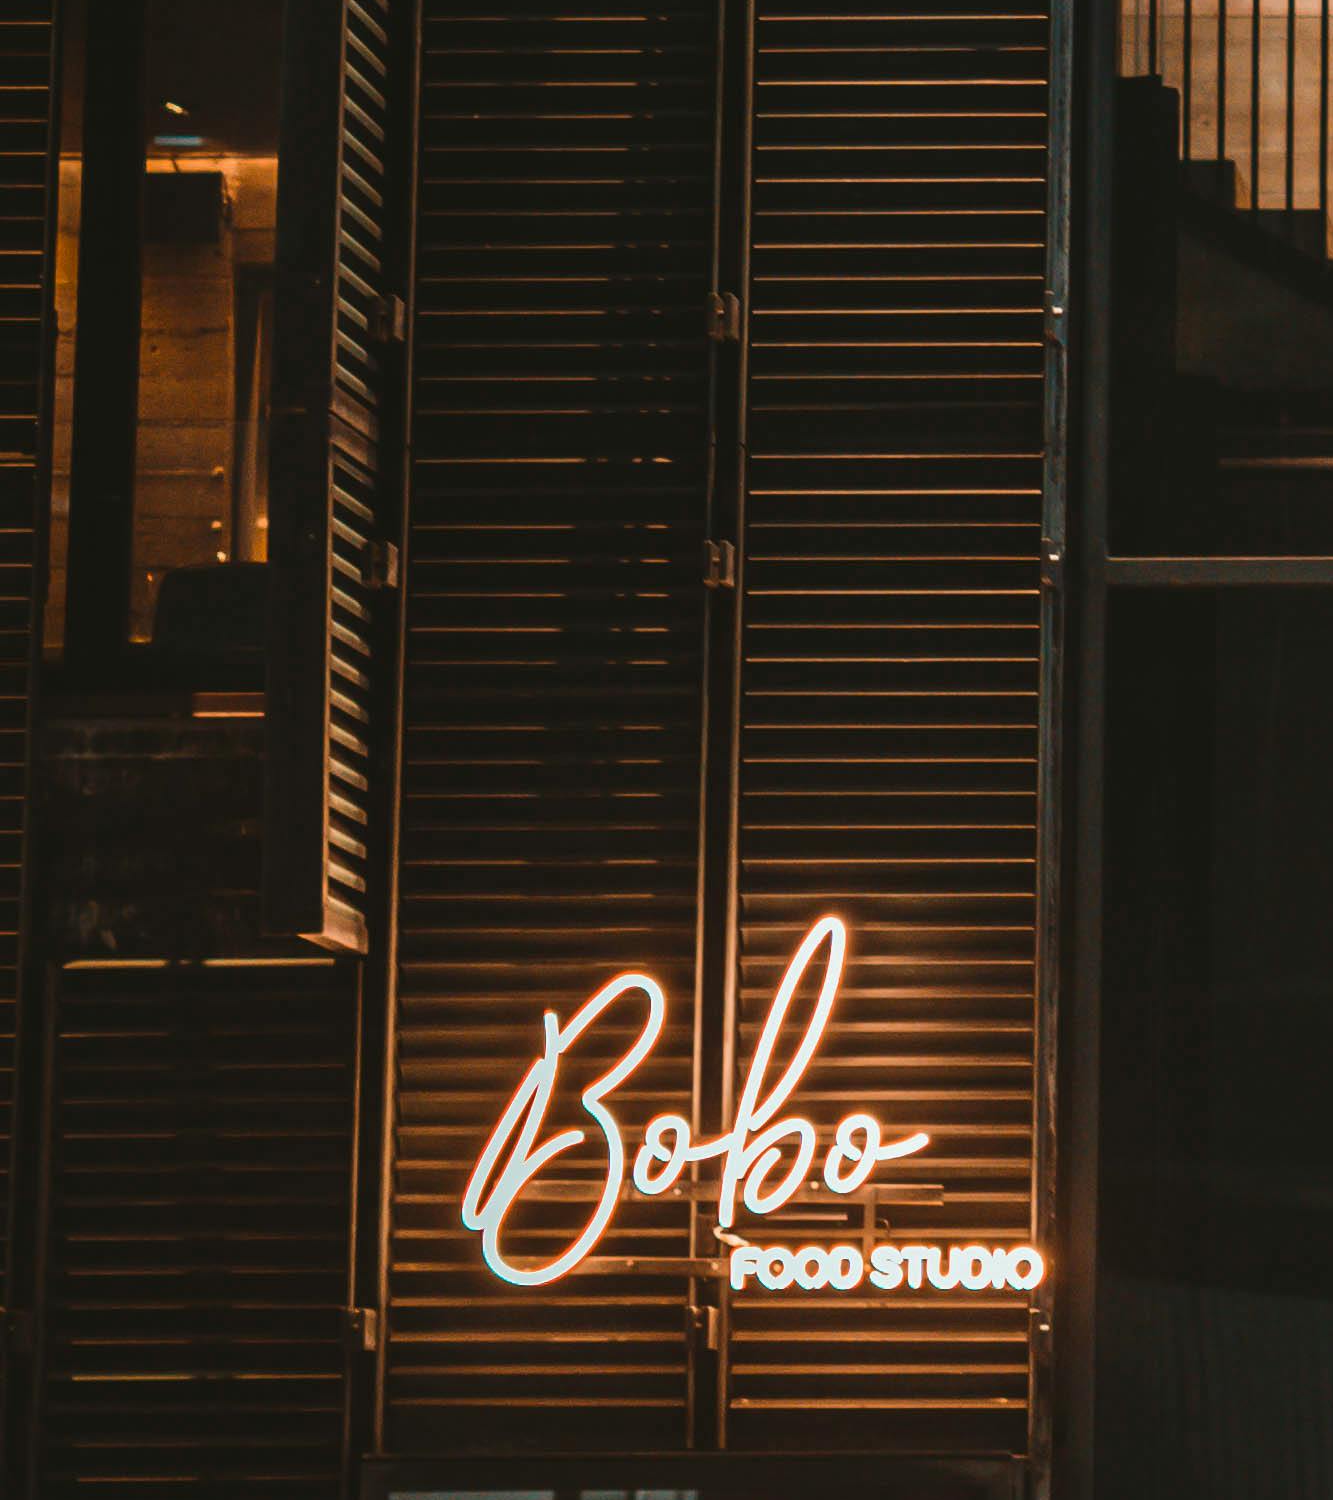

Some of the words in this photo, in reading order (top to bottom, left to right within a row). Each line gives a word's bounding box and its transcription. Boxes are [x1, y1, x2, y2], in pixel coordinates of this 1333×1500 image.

[460, 915, 931, 1288] Bobo
[729, 1245, 864, 1291] FOOD
[869, 1245, 1045, 1291] STUDIO
